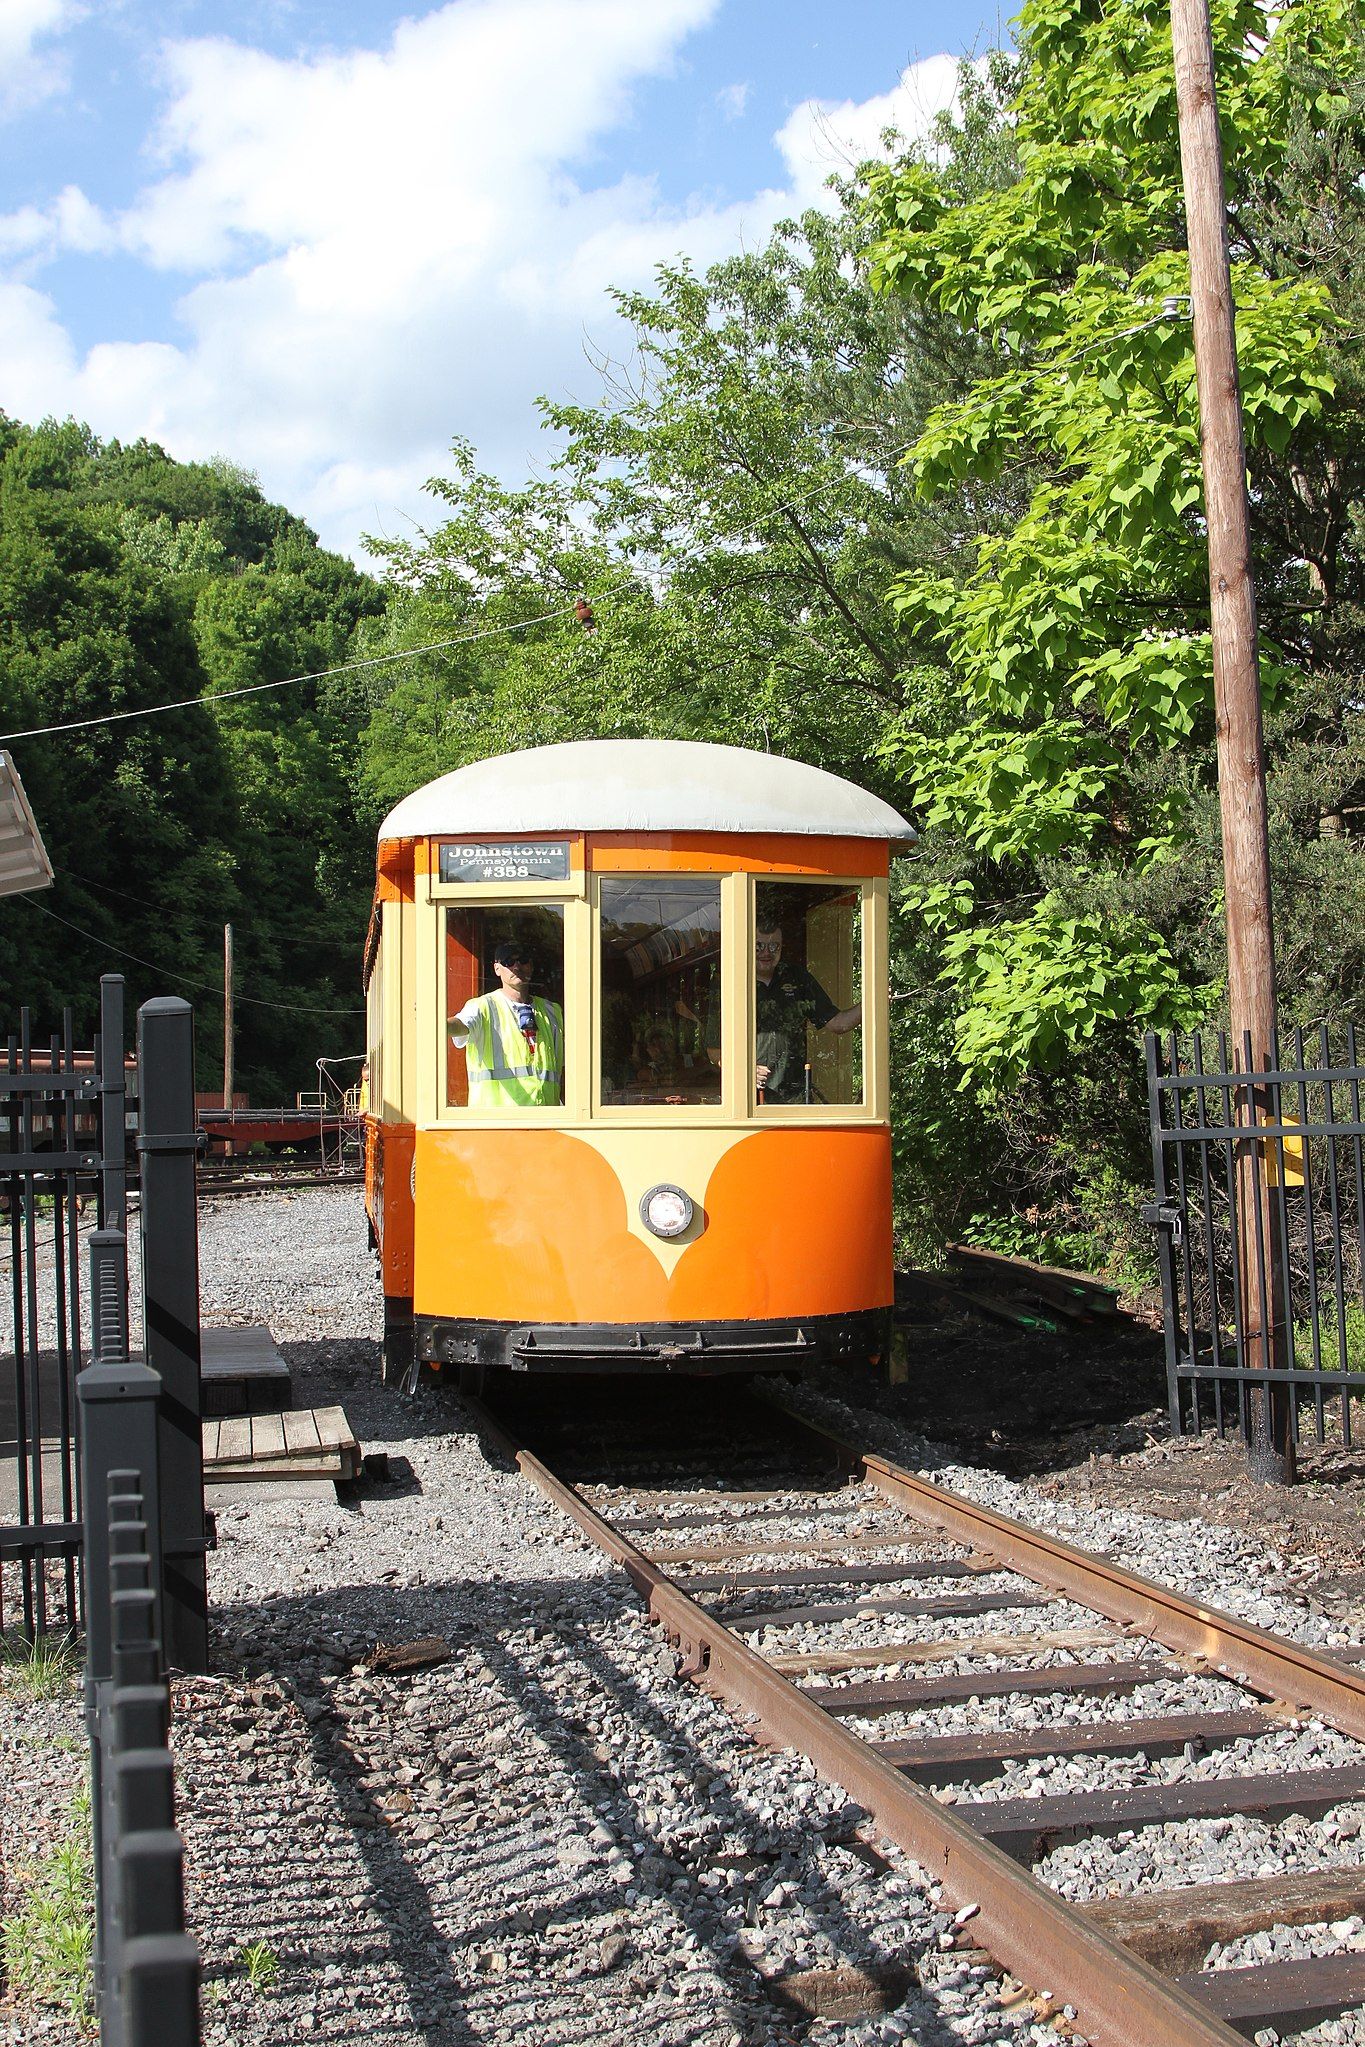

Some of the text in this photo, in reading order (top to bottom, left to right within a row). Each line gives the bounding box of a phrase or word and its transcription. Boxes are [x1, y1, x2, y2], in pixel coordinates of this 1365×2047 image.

[448, 845, 563, 857] Johnstown
[460, 857, 551, 866] Pennsylvania
[483, 866, 529, 878] #358
